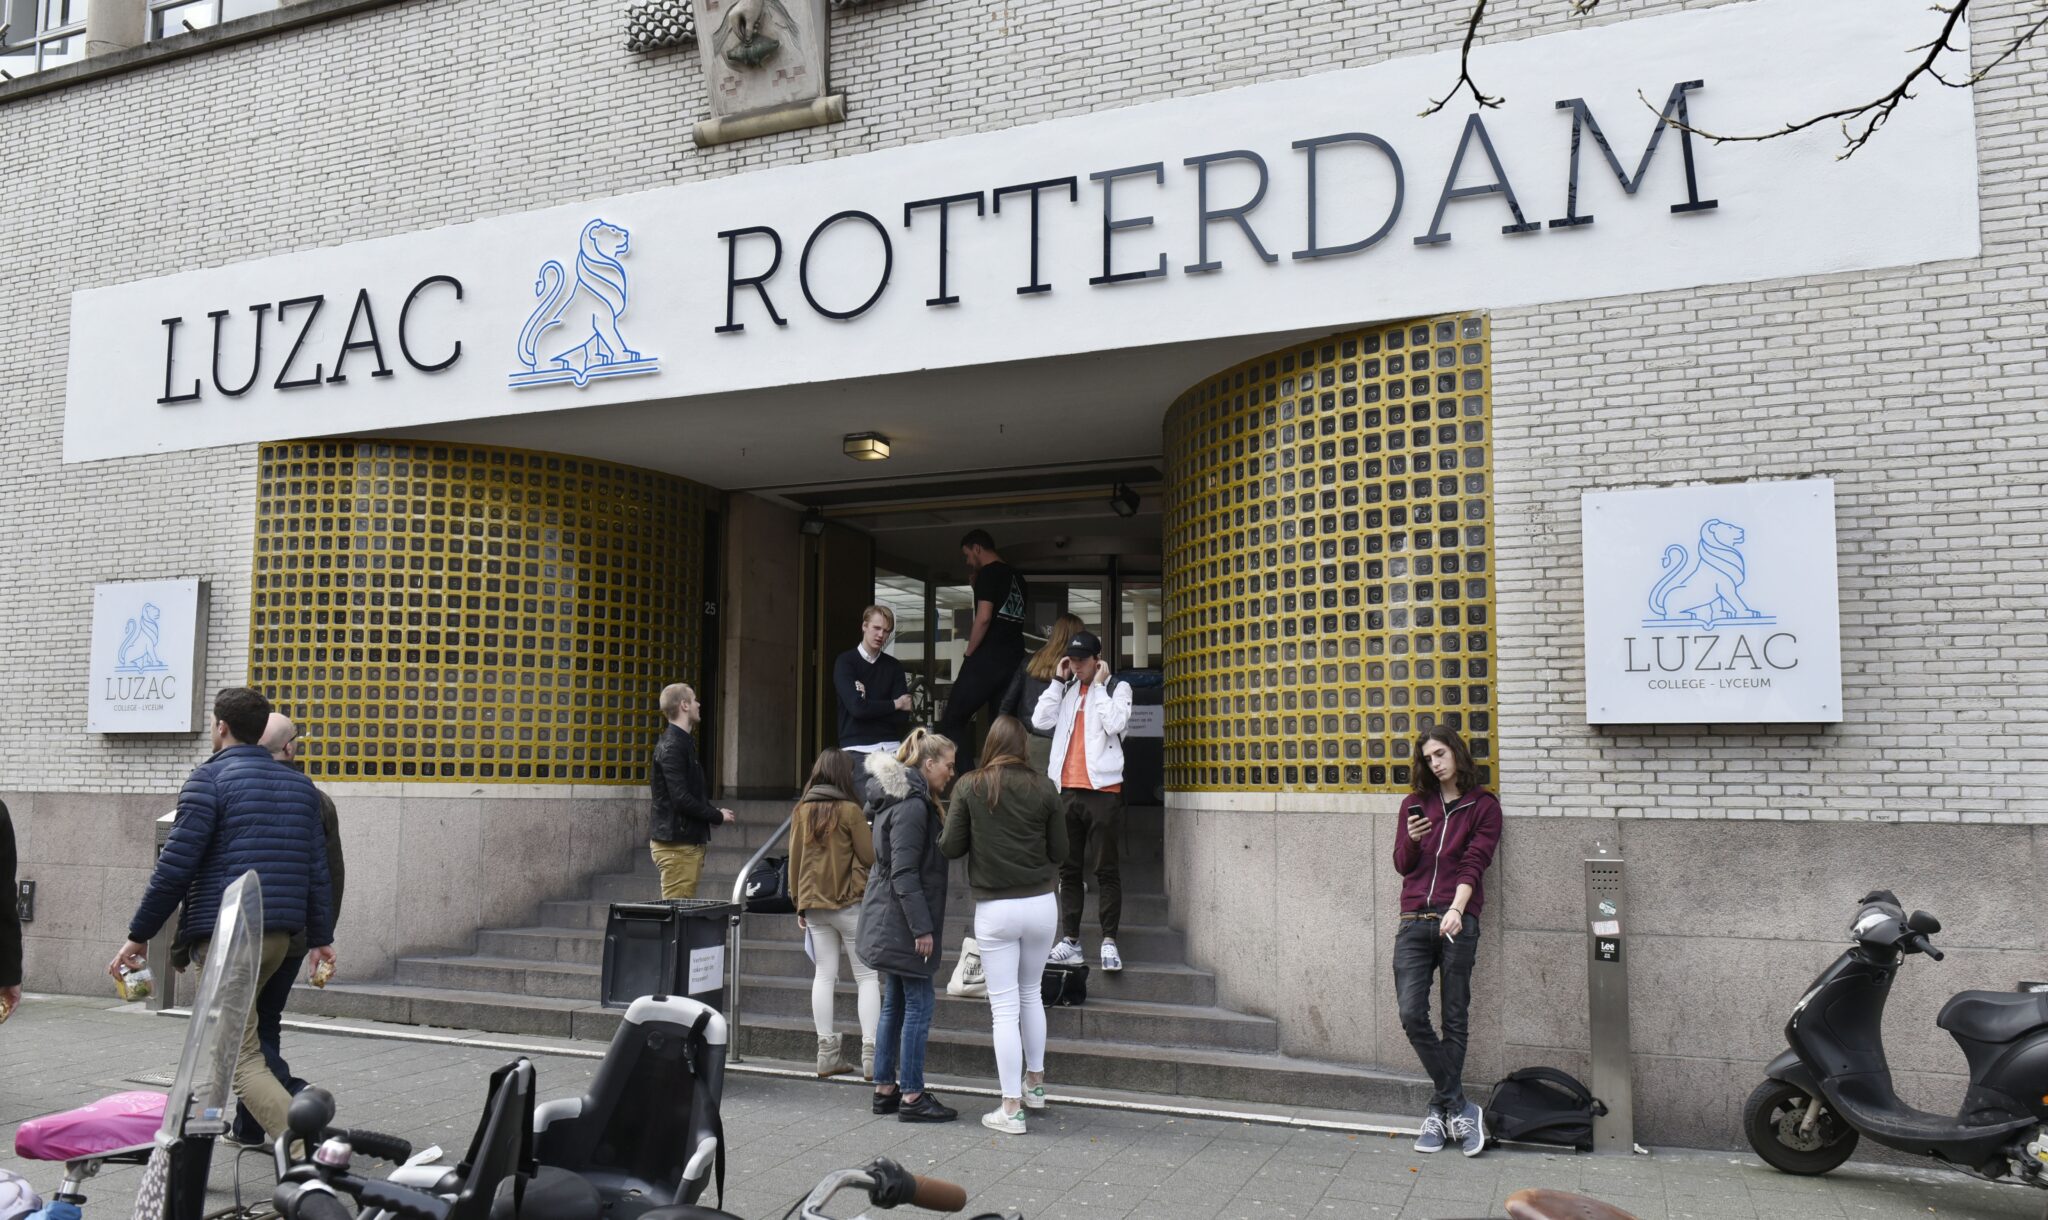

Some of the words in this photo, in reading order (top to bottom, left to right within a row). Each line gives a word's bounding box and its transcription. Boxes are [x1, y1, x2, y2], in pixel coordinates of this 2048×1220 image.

[157, 275, 463, 404] LUZAC
[715, 79, 1718, 333] ROTTERDAM
[705, 601, 716, 615] 25
[1624, 633, 1798, 672] LUZAC
[105, 675, 176, 701] LUZAC
[1648, 679, 1706, 690] COLLEGE
[1719, 677, 1771, 688] LYCEUM
[113, 704, 138, 712] COLLEGE
[142, 703, 164, 711] LYCEUM
[1600, 941, 1615, 951] Lee
